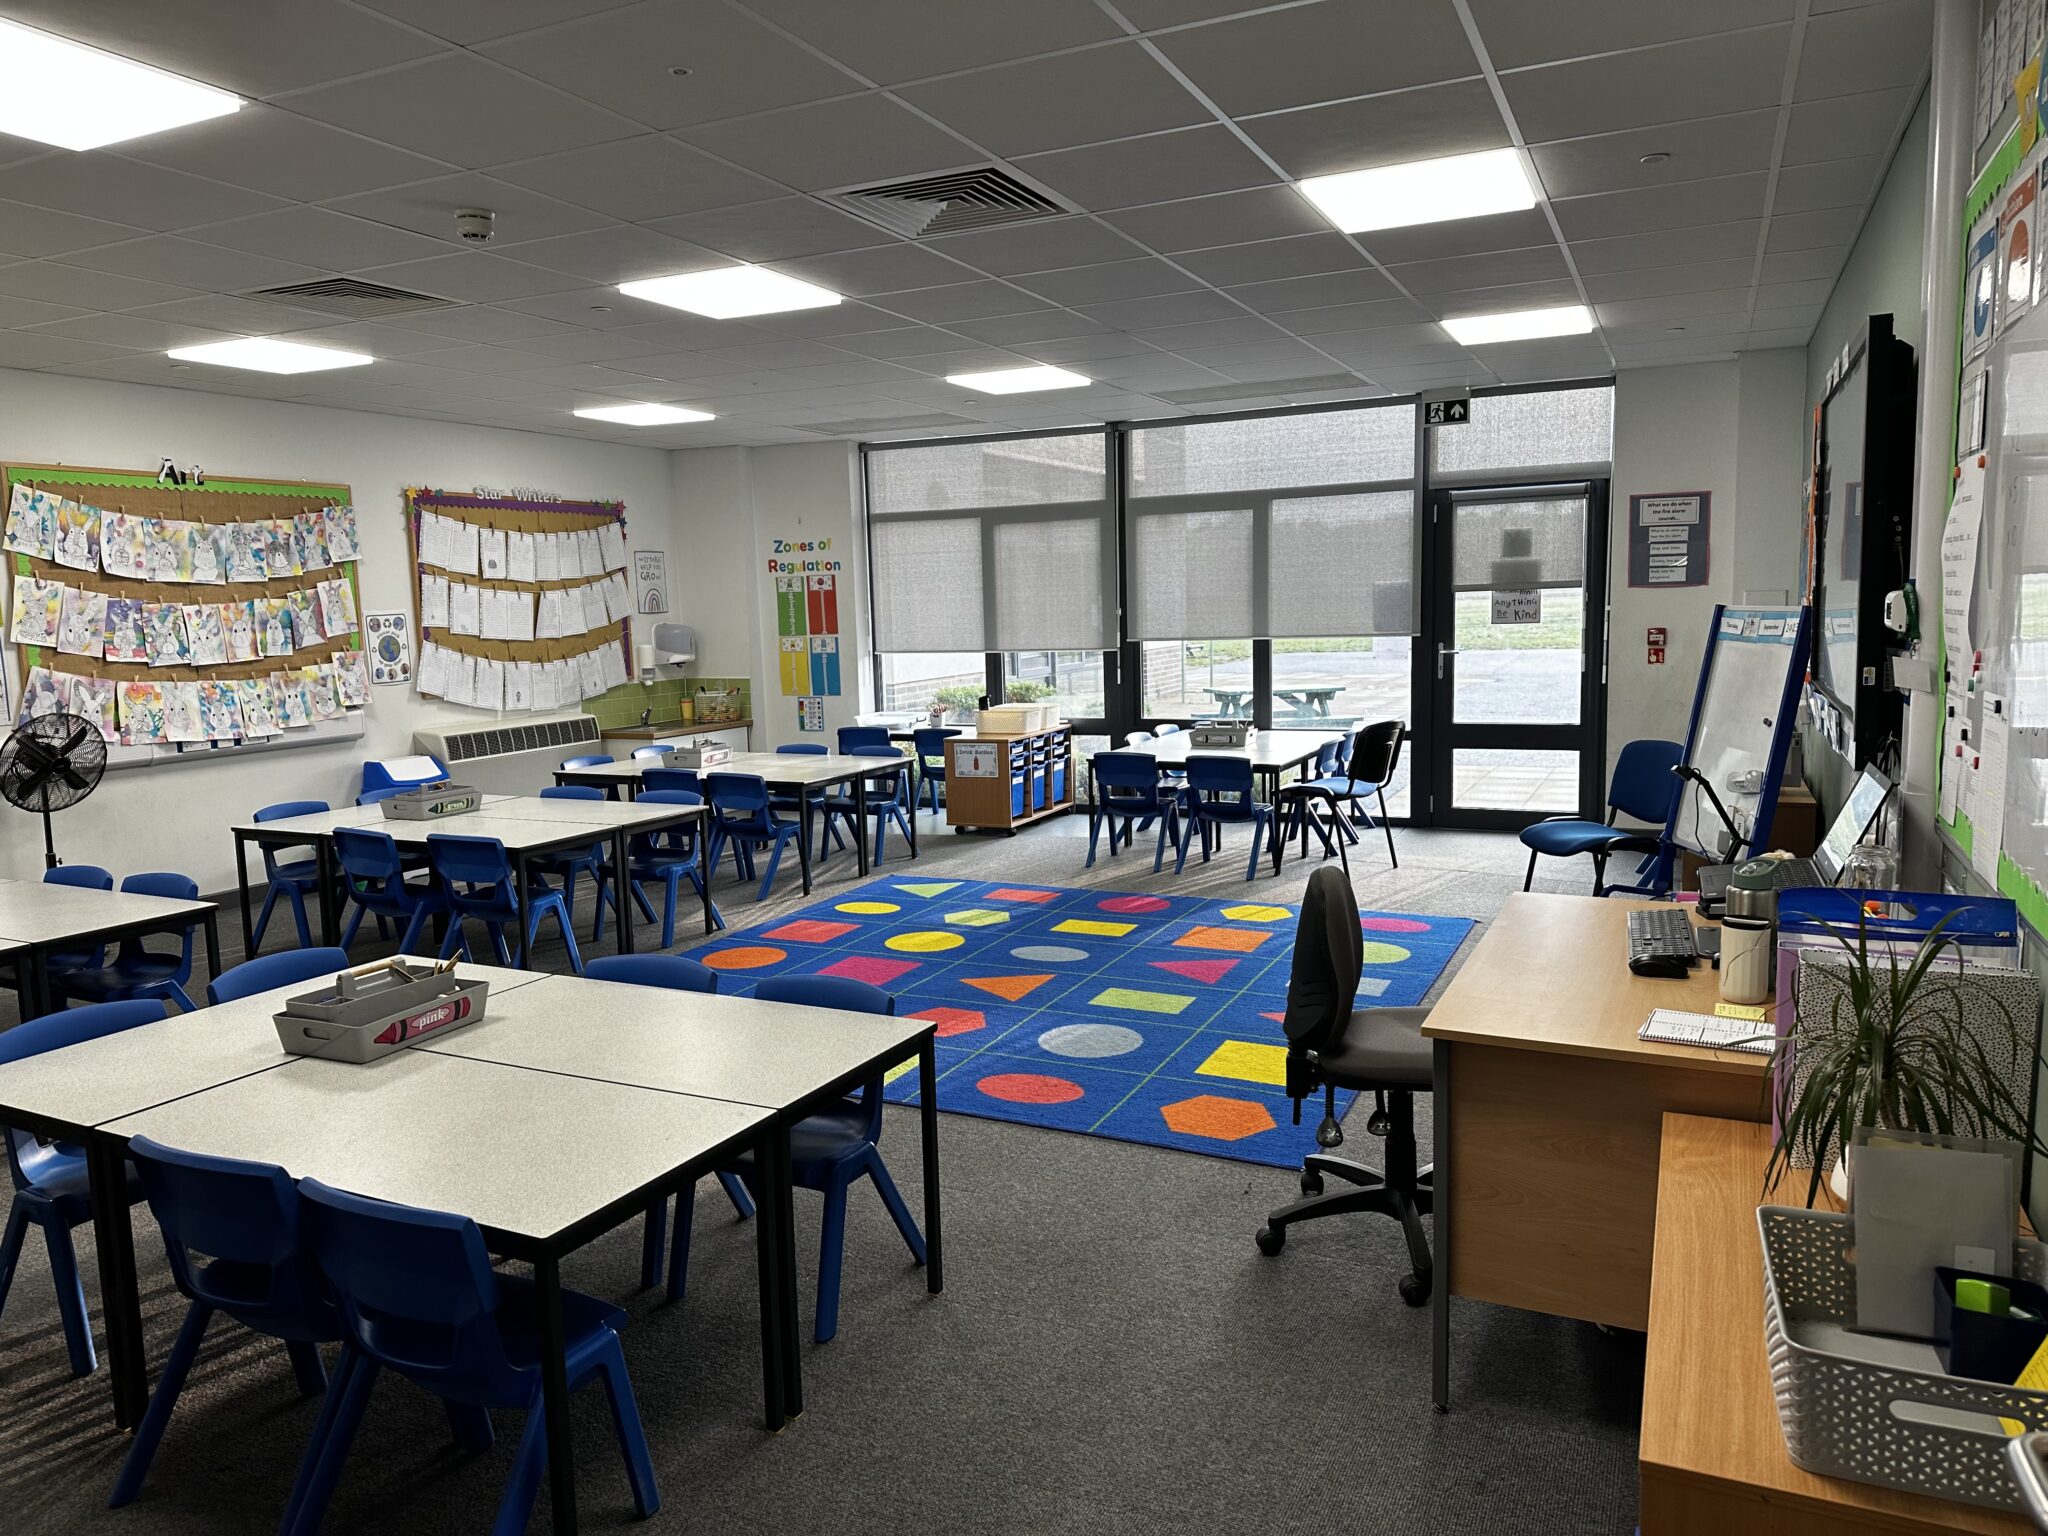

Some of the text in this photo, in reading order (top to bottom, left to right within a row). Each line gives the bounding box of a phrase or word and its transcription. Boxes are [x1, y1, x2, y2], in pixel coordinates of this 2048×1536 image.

[157, 458, 204, 485] Art
[476, 485, 562, 503] Star Writers
[773, 538, 832, 553] Zones of
[768, 559, 841, 574] Regulation
[419, 1008, 445, 1030] pink
